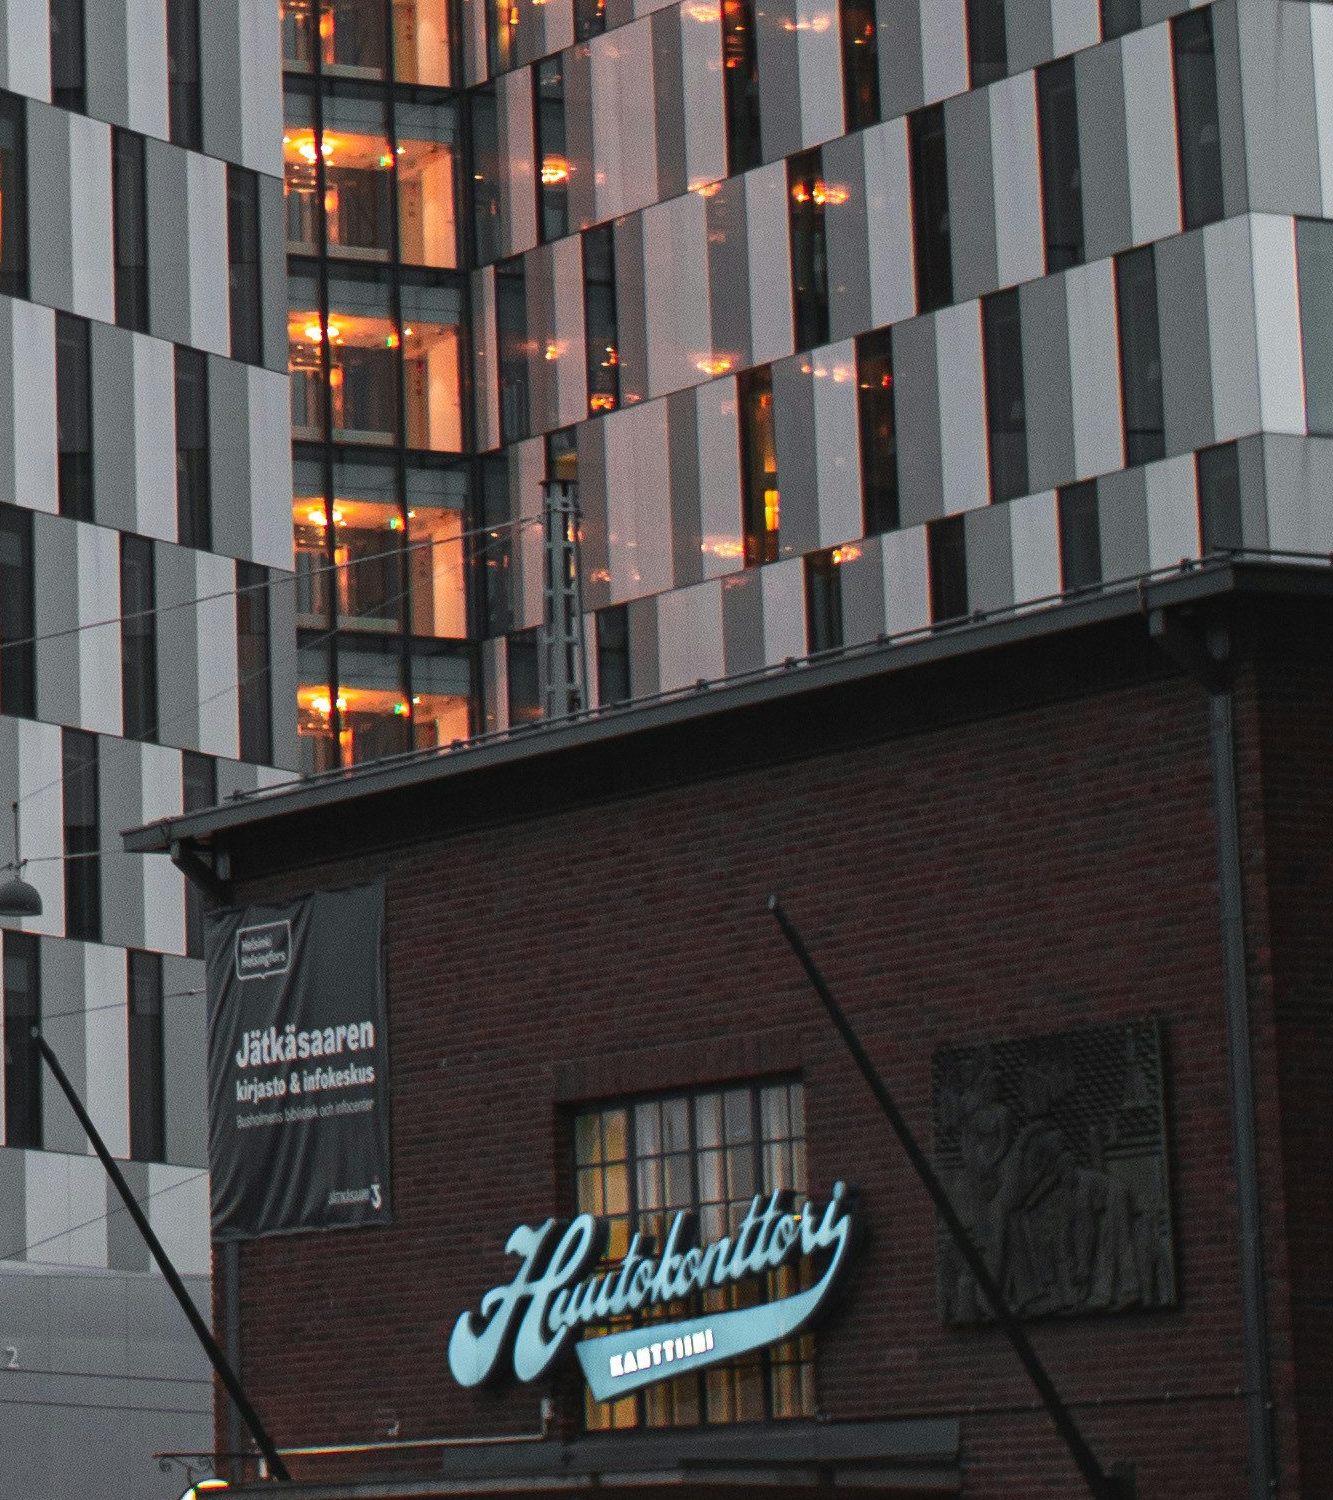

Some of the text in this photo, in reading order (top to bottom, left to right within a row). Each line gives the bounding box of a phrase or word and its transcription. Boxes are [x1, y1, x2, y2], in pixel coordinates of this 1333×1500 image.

[236, 1021, 375, 1068] Jätkäsaaren
[237, 1063, 375, 1104] kirjasto & infokeskus
[448, 1180, 852, 1388] Huutokonttori
[5, 1345, 21, 1369] 2
[609, 1327, 715, 1378] KANTTIINI
